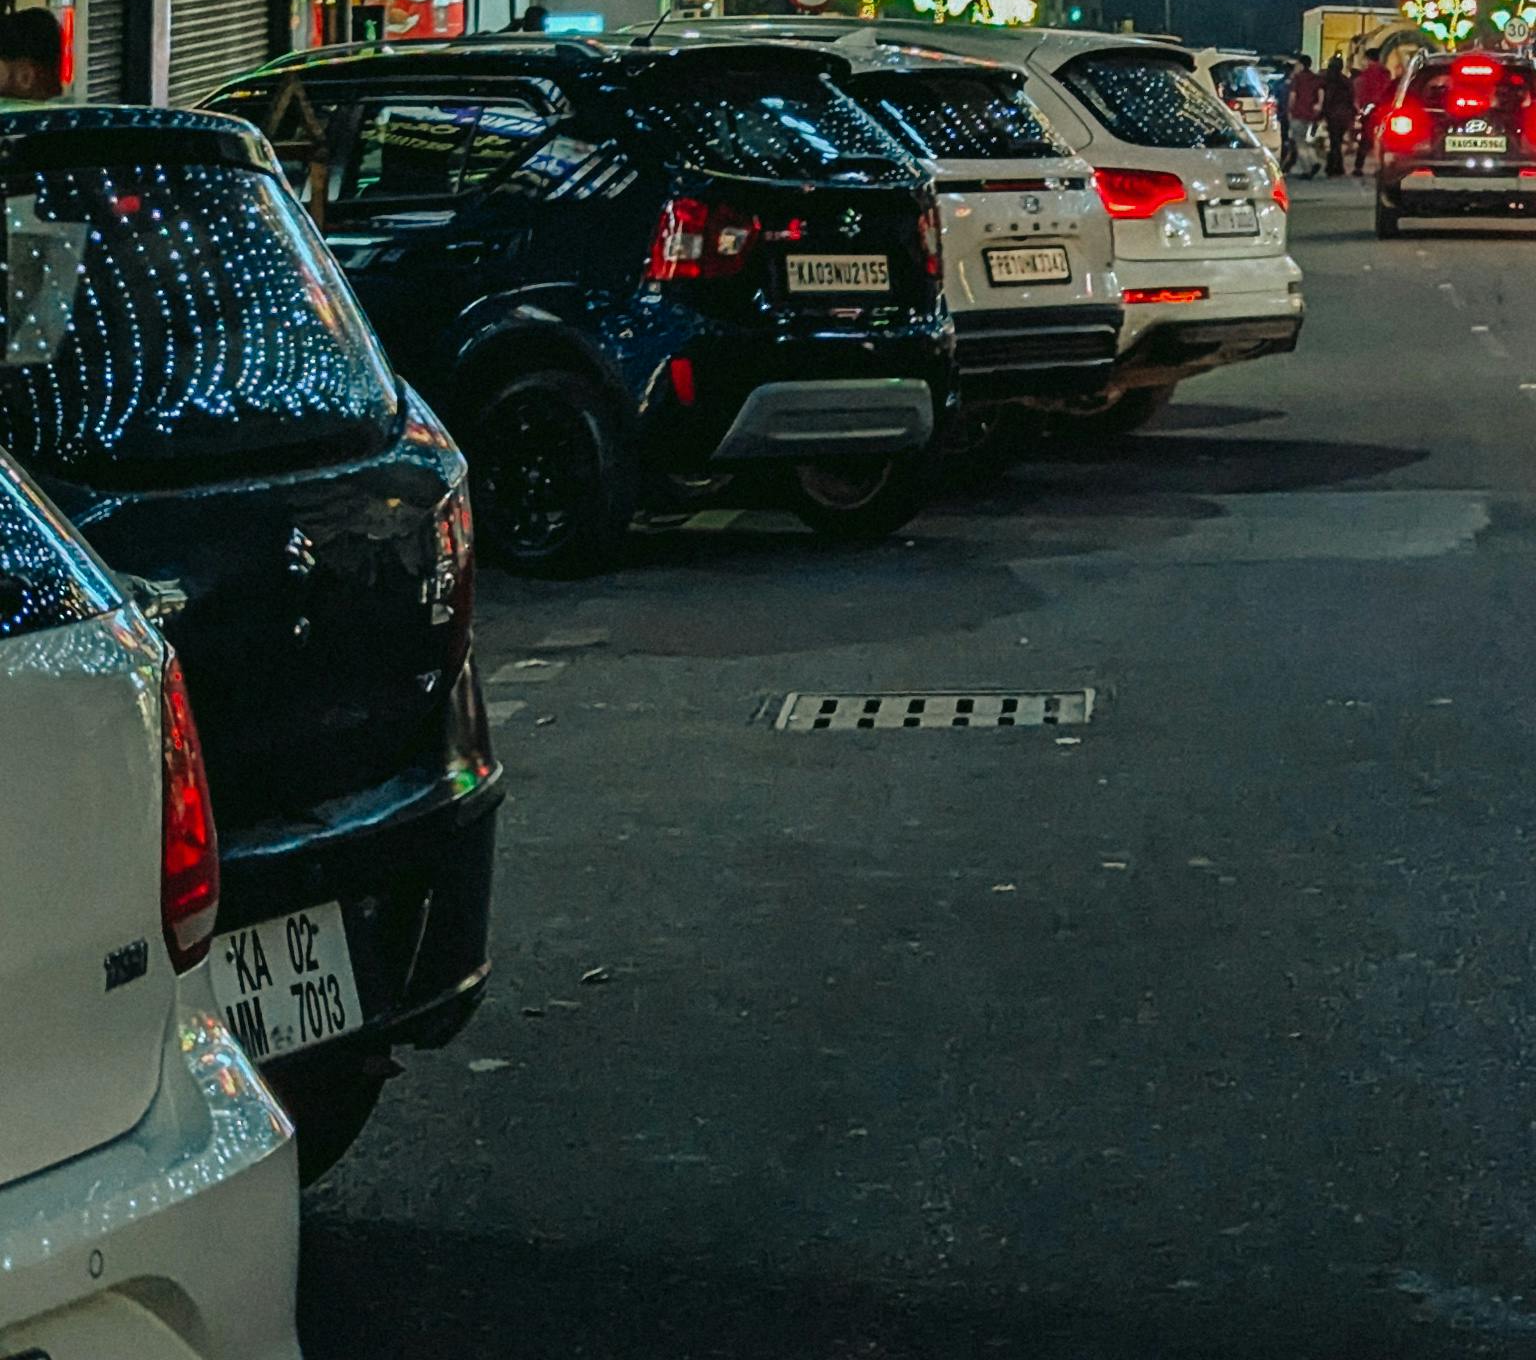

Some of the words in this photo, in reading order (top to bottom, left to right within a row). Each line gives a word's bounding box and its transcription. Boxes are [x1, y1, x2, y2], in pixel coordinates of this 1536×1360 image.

[1507, 23, 1527, 38] 30
[231, 932, 273, 995] KA
[285, 915, 320, 976] 02
[290, 972, 347, 1044] 7013
